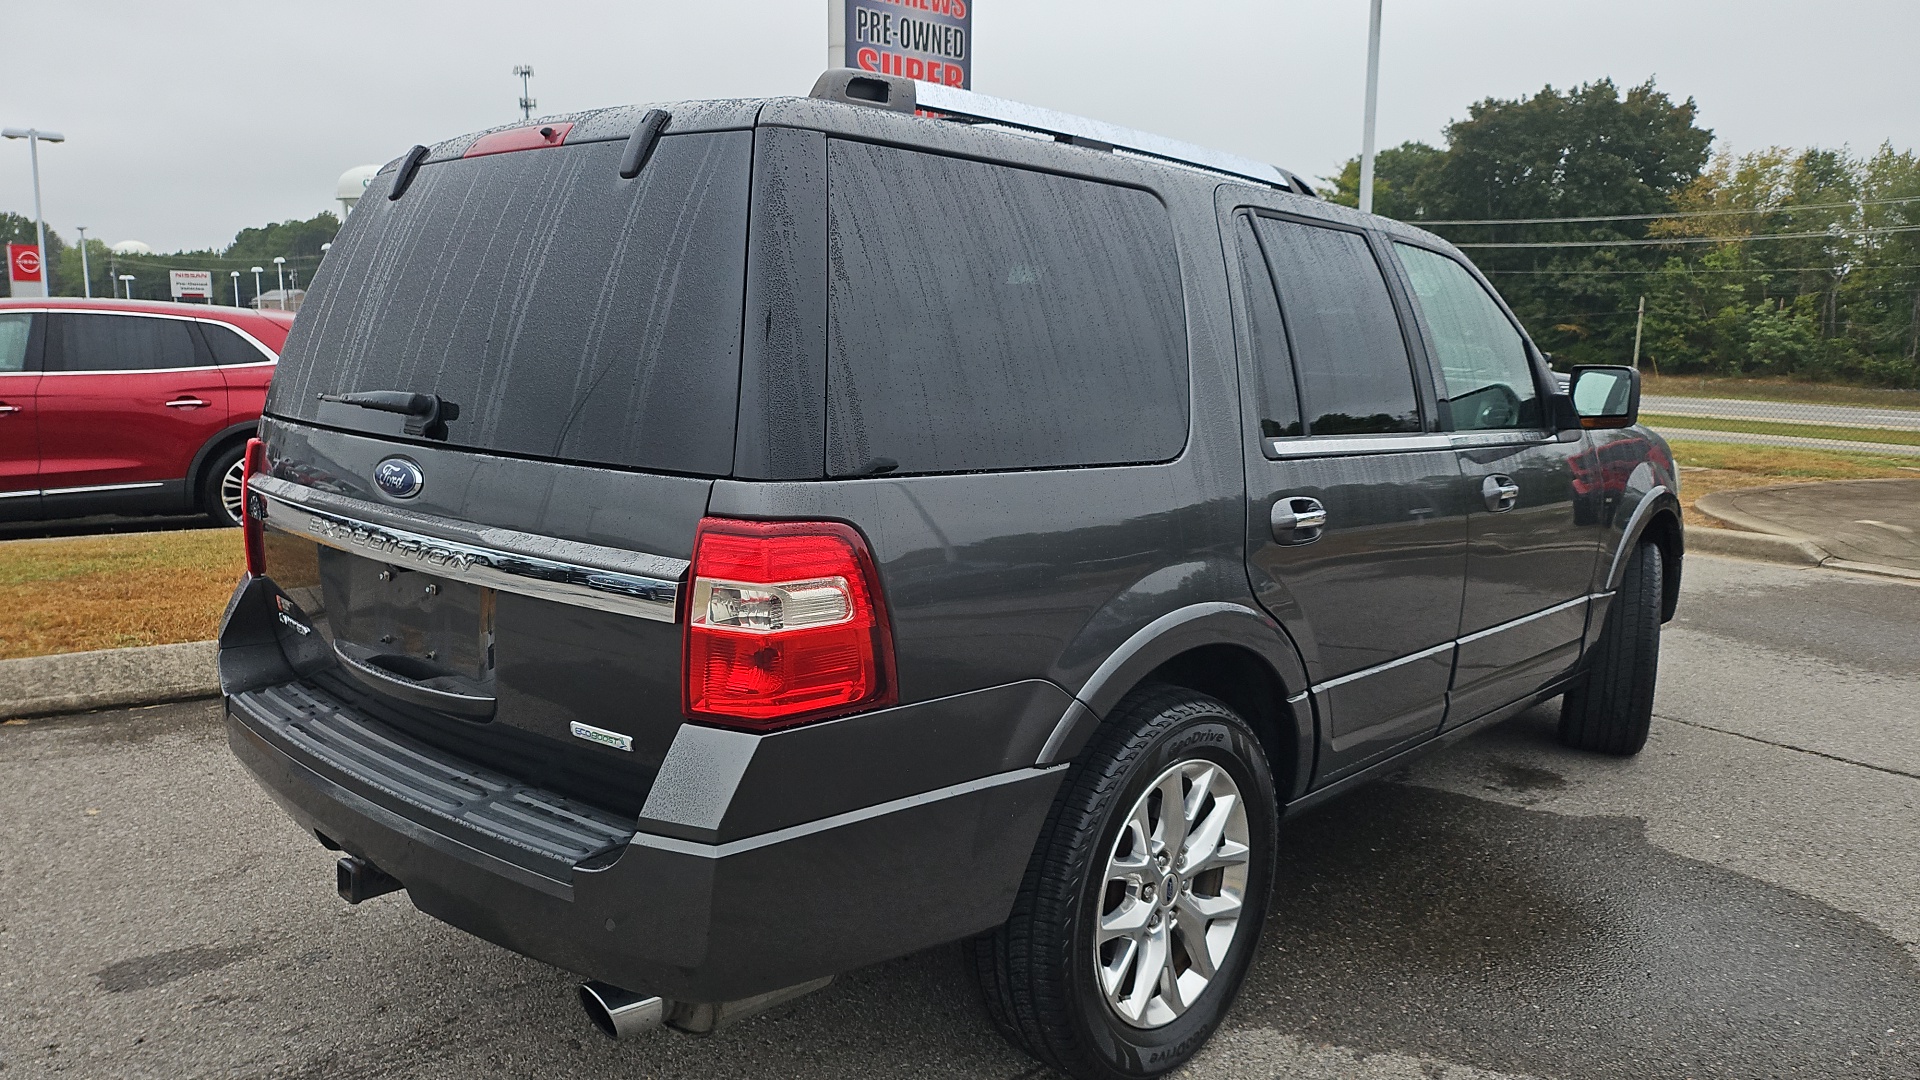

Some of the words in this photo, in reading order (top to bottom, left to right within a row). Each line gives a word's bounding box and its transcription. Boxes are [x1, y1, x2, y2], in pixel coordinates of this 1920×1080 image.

[856, 7, 964, 59] PRE-OWNED
[378, 463, 407, 489] Ford
[307, 516, 477, 573] EXPEDITION
